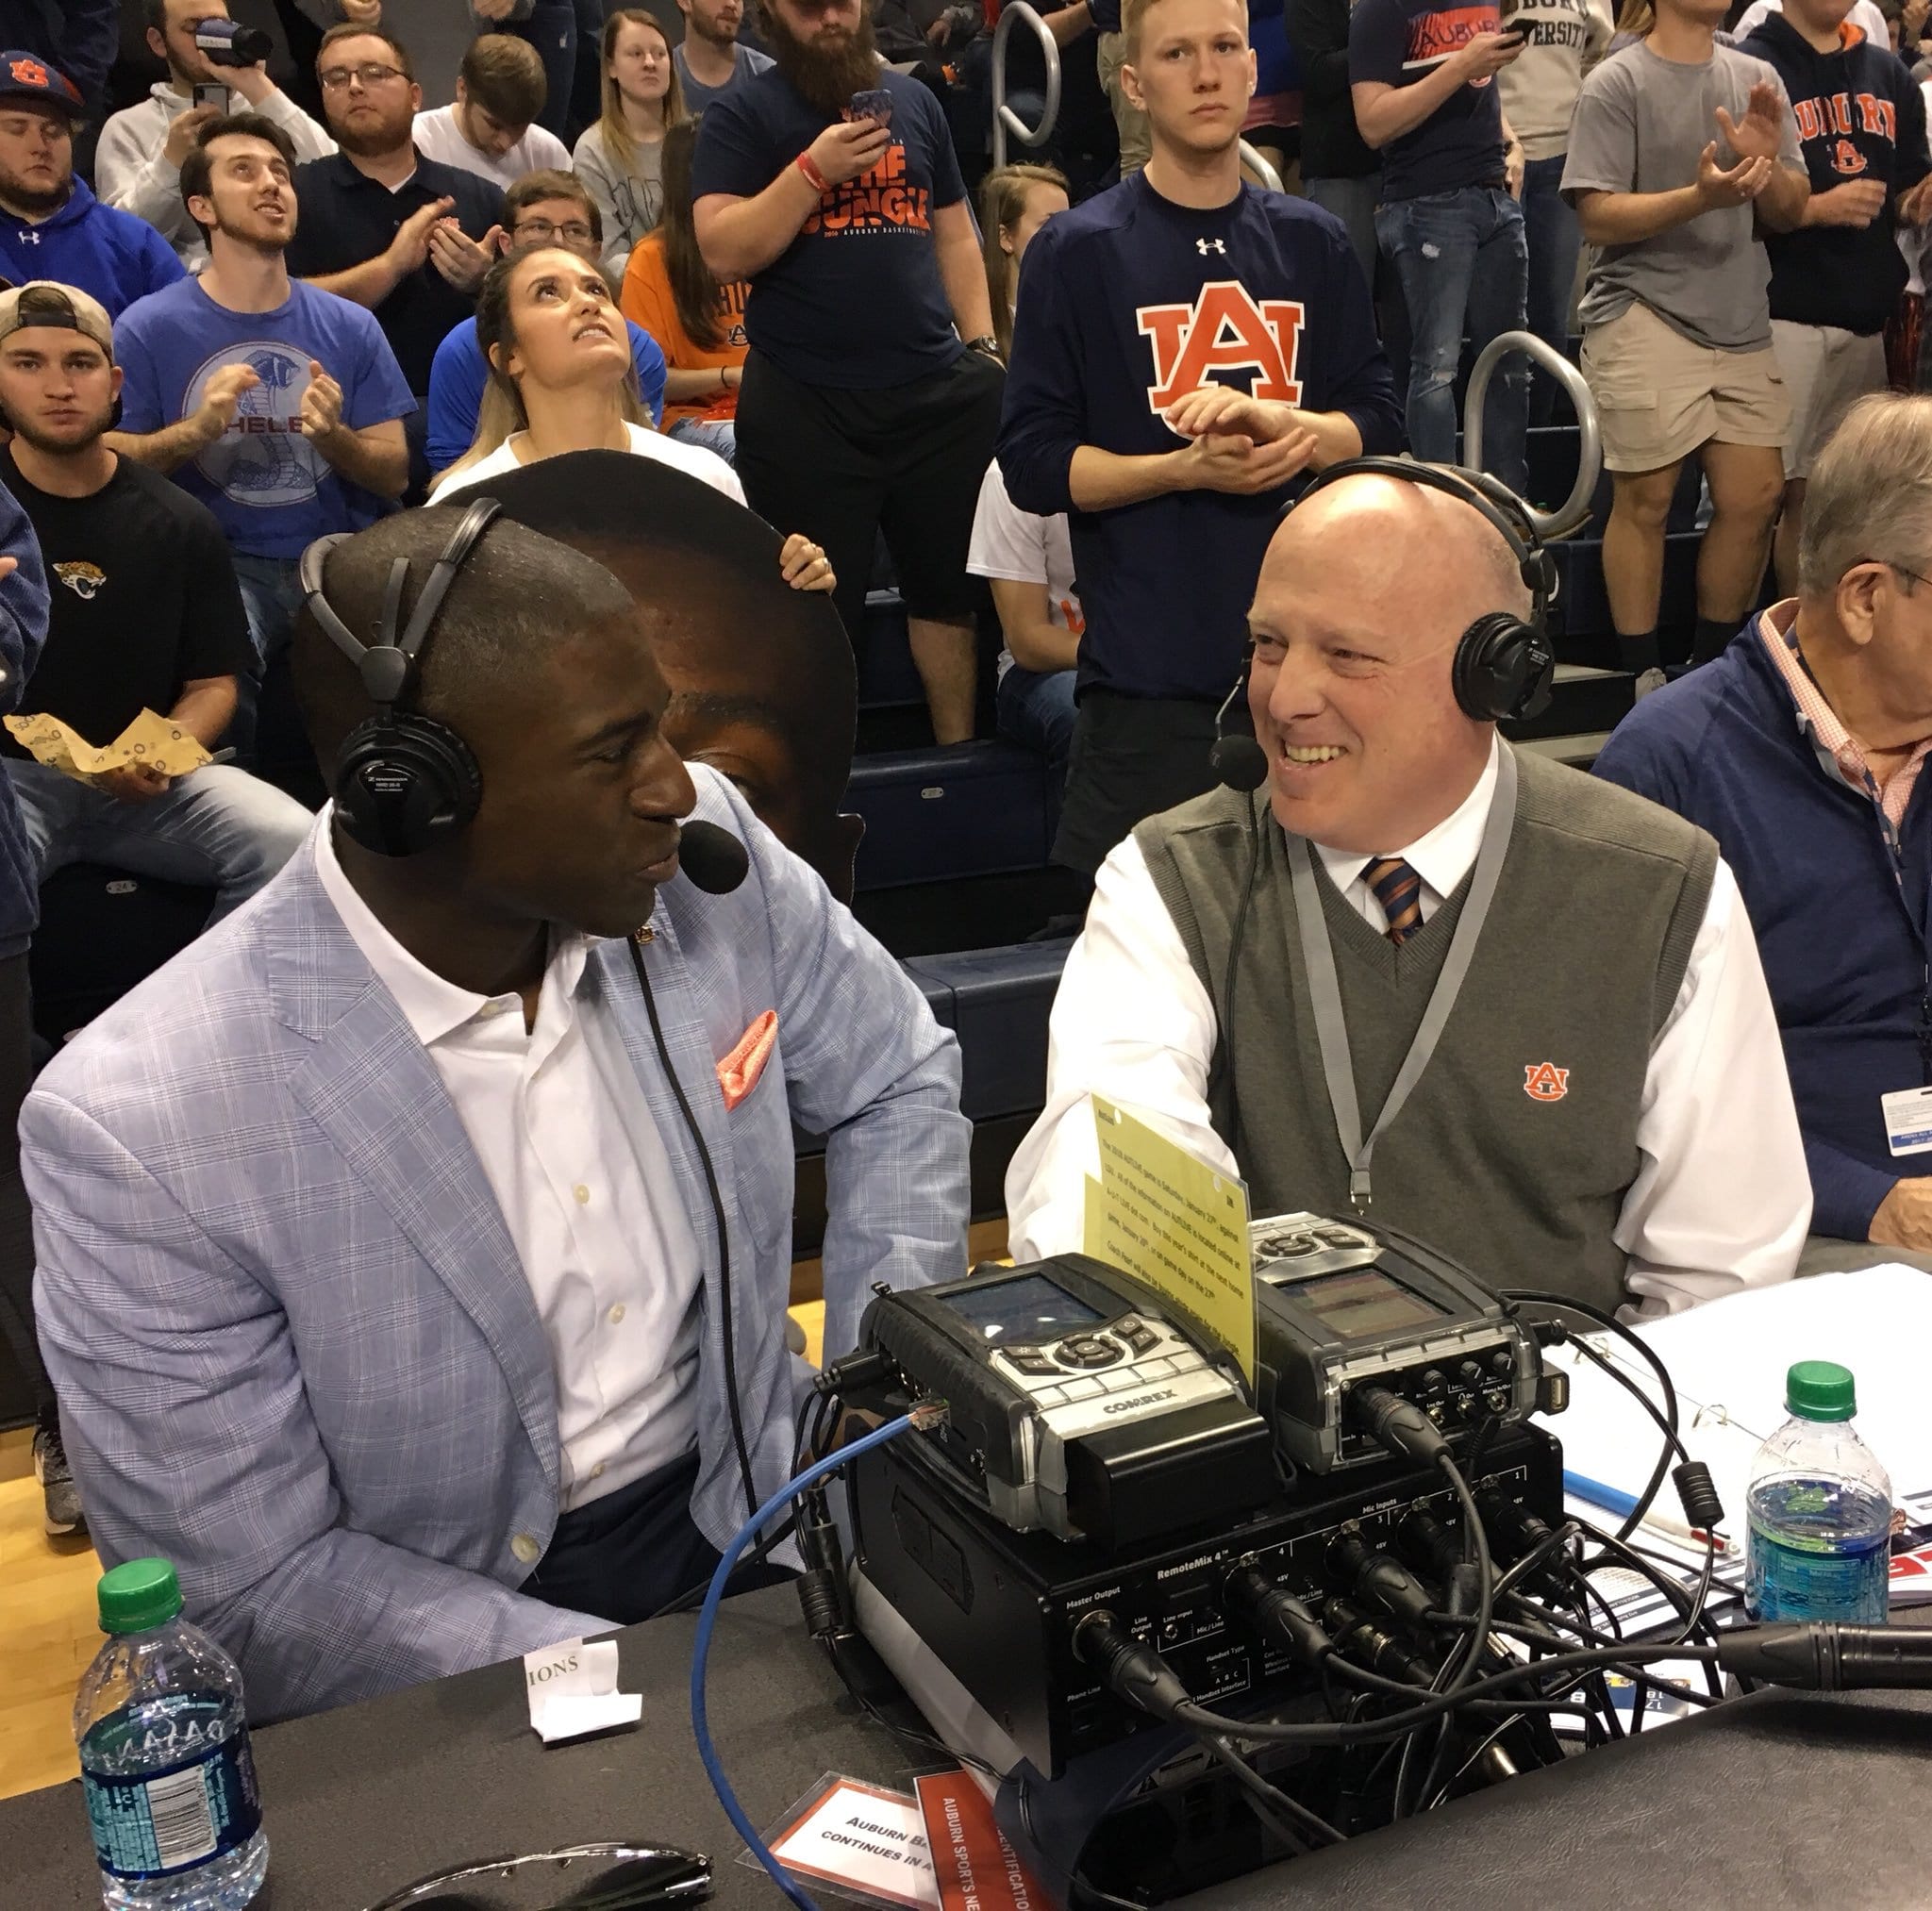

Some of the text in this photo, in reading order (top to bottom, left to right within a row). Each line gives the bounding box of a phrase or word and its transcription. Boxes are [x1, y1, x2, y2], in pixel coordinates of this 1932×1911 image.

[1103, 1388, 1178, 1414] COMREX
[1515, 1471, 1521, 1480] 1
[1362, 1497, 1397, 1515] Mic Inputs
[1447, 1492, 1453, 1502] 2
[1278, 1547, 1285, 1555] 4
[1157, 1555, 1213, 1580] RemoteMix
[1066, 1586, 1121, 1610] Master Output
[1131, 1621, 1152, 1634] Output
[1134, 1615, 1148, 1625] Line
[528, 1655, 578, 1687] IONS
[845, 1817, 908, 1842] AUBURN
[821, 1831, 903, 1861] CONTINUES
[904, 1855, 923, 1868] IN
[943, 1797, 964, 1844] AUBURN
[954, 1845, 975, 1893] SPORTS
